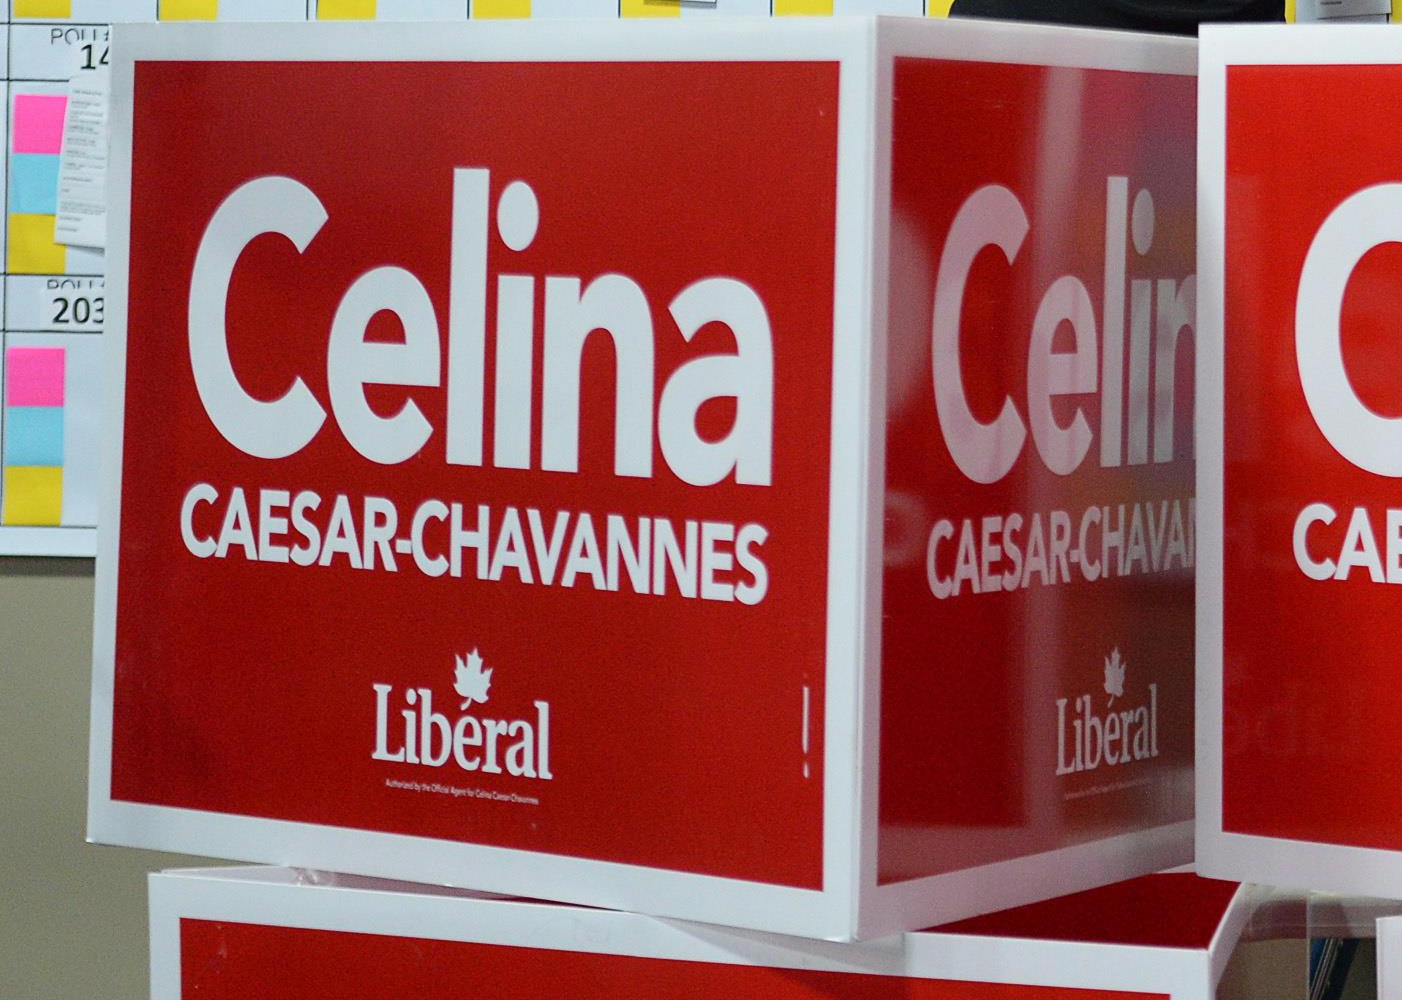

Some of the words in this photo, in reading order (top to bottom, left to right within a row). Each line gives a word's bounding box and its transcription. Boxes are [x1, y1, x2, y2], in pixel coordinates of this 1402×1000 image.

[52, 297, 105, 325] 203
[186, 166, 774, 488] Celina
[931, 175, 1197, 486] Celin
[180, 482, 770, 606] CAESAR-CHAVANNES
[372, 683, 553, 780] Libéral
